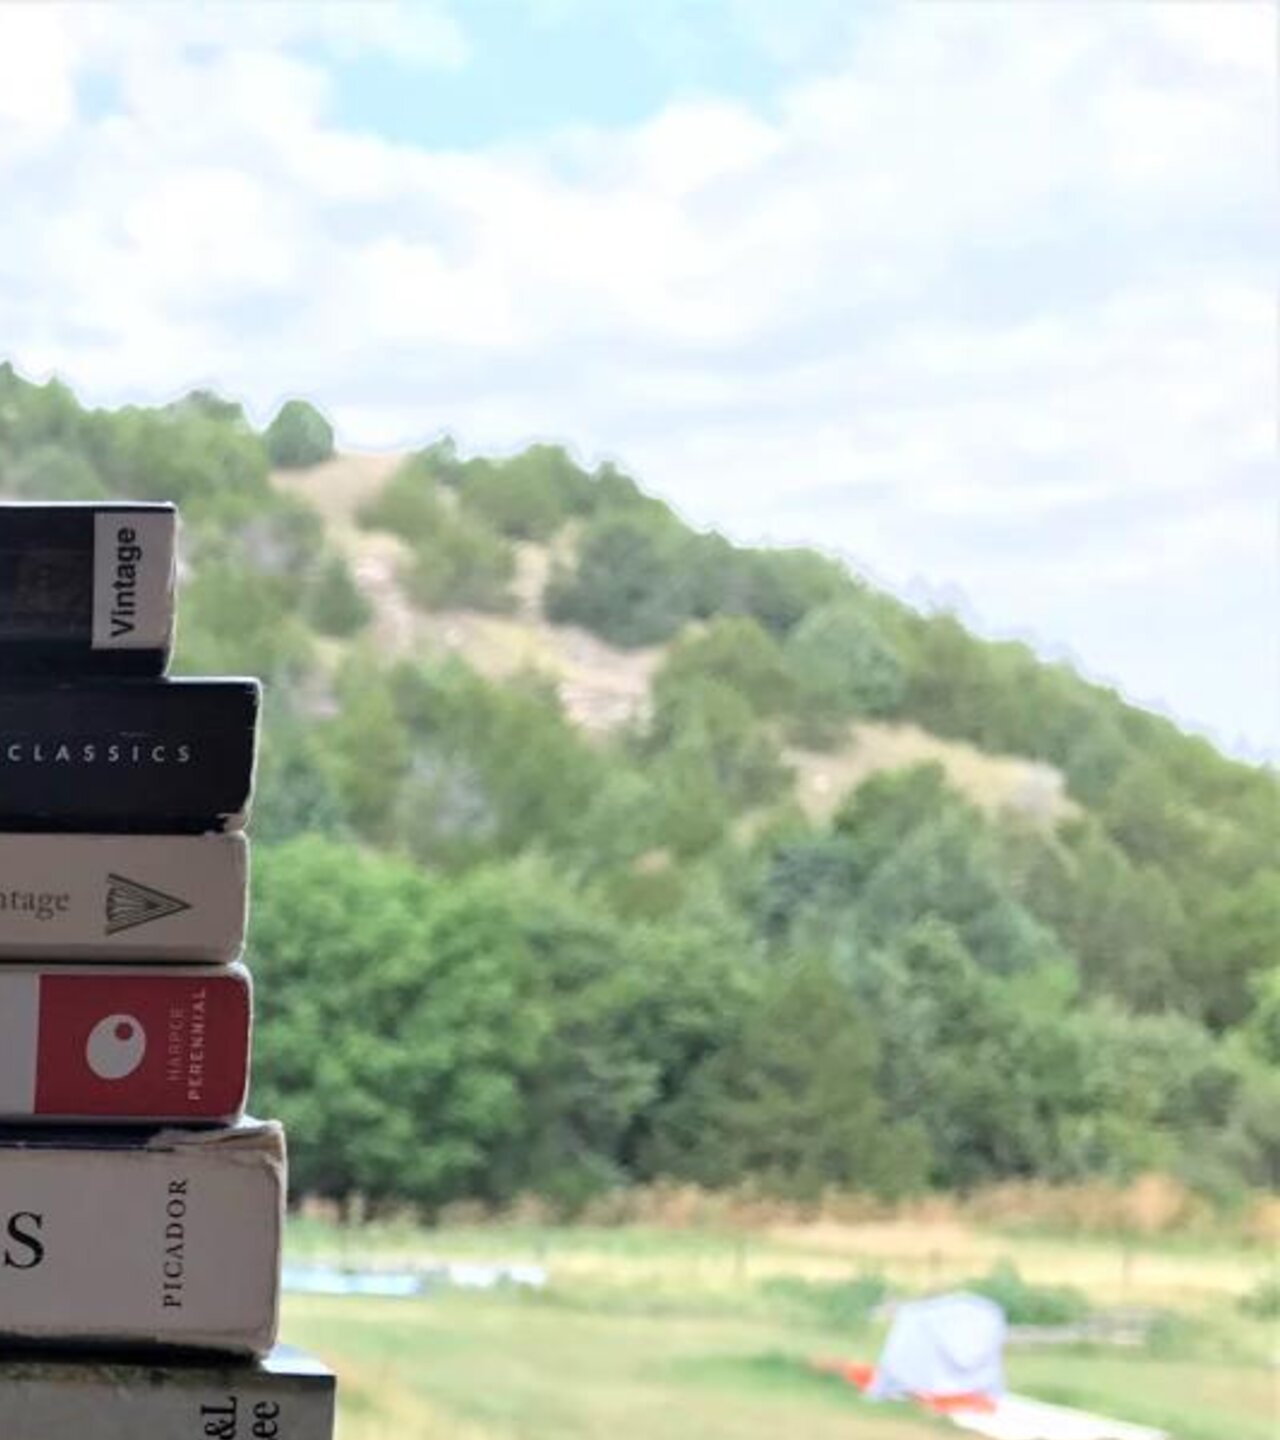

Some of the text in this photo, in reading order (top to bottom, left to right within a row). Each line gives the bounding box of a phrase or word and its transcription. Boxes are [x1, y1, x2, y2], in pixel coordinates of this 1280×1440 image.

[111, 527, 141, 637] Vintage
[7, 743, 191, 763] CLASSICS
[188, 988, 206, 1101] PERENNIAL
[163, 1176, 188, 1309] PICADOR
